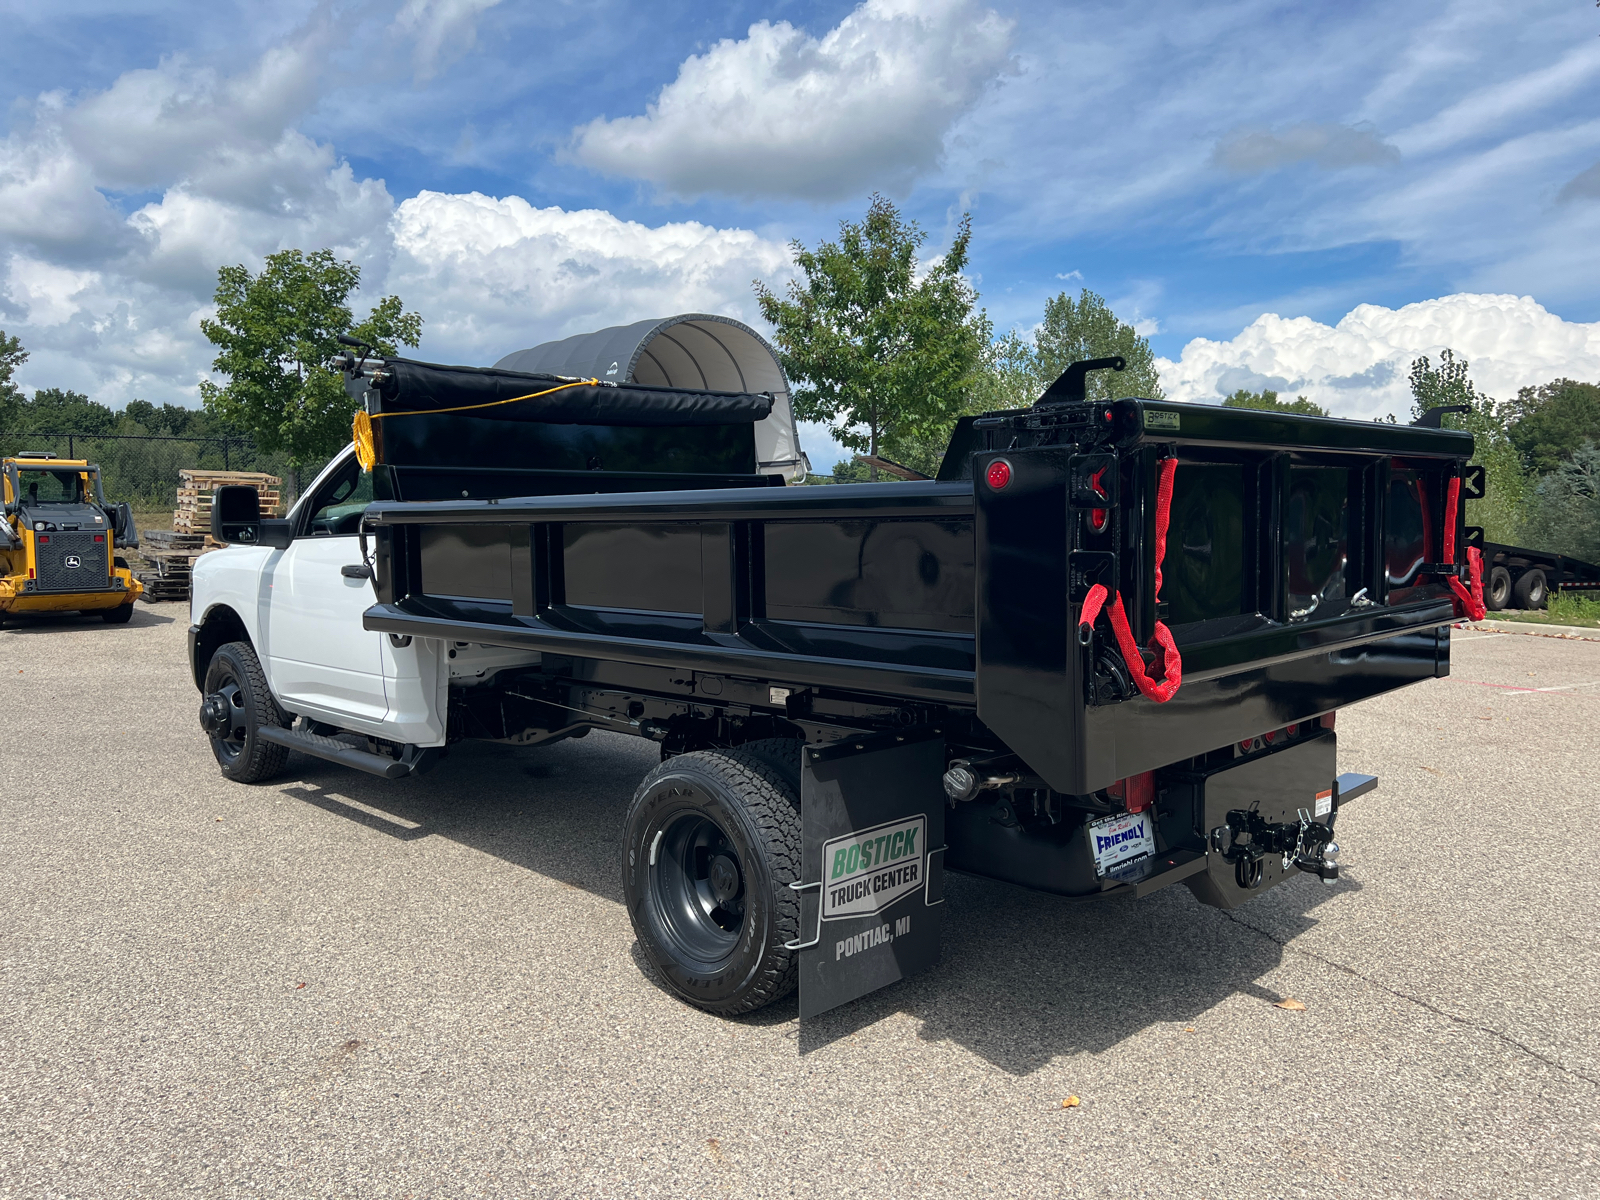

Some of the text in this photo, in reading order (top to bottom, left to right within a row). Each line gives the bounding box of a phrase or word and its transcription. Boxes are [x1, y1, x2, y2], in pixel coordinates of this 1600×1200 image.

[1147, 411, 1178, 423] BOSTICK
[831, 826, 919, 880] BOSTICK
[1096, 819, 1145, 855] FRIENDLY
[830, 863, 918, 909] TRUCK CENTER
[835, 915, 911, 961] PONTIAC, MI
